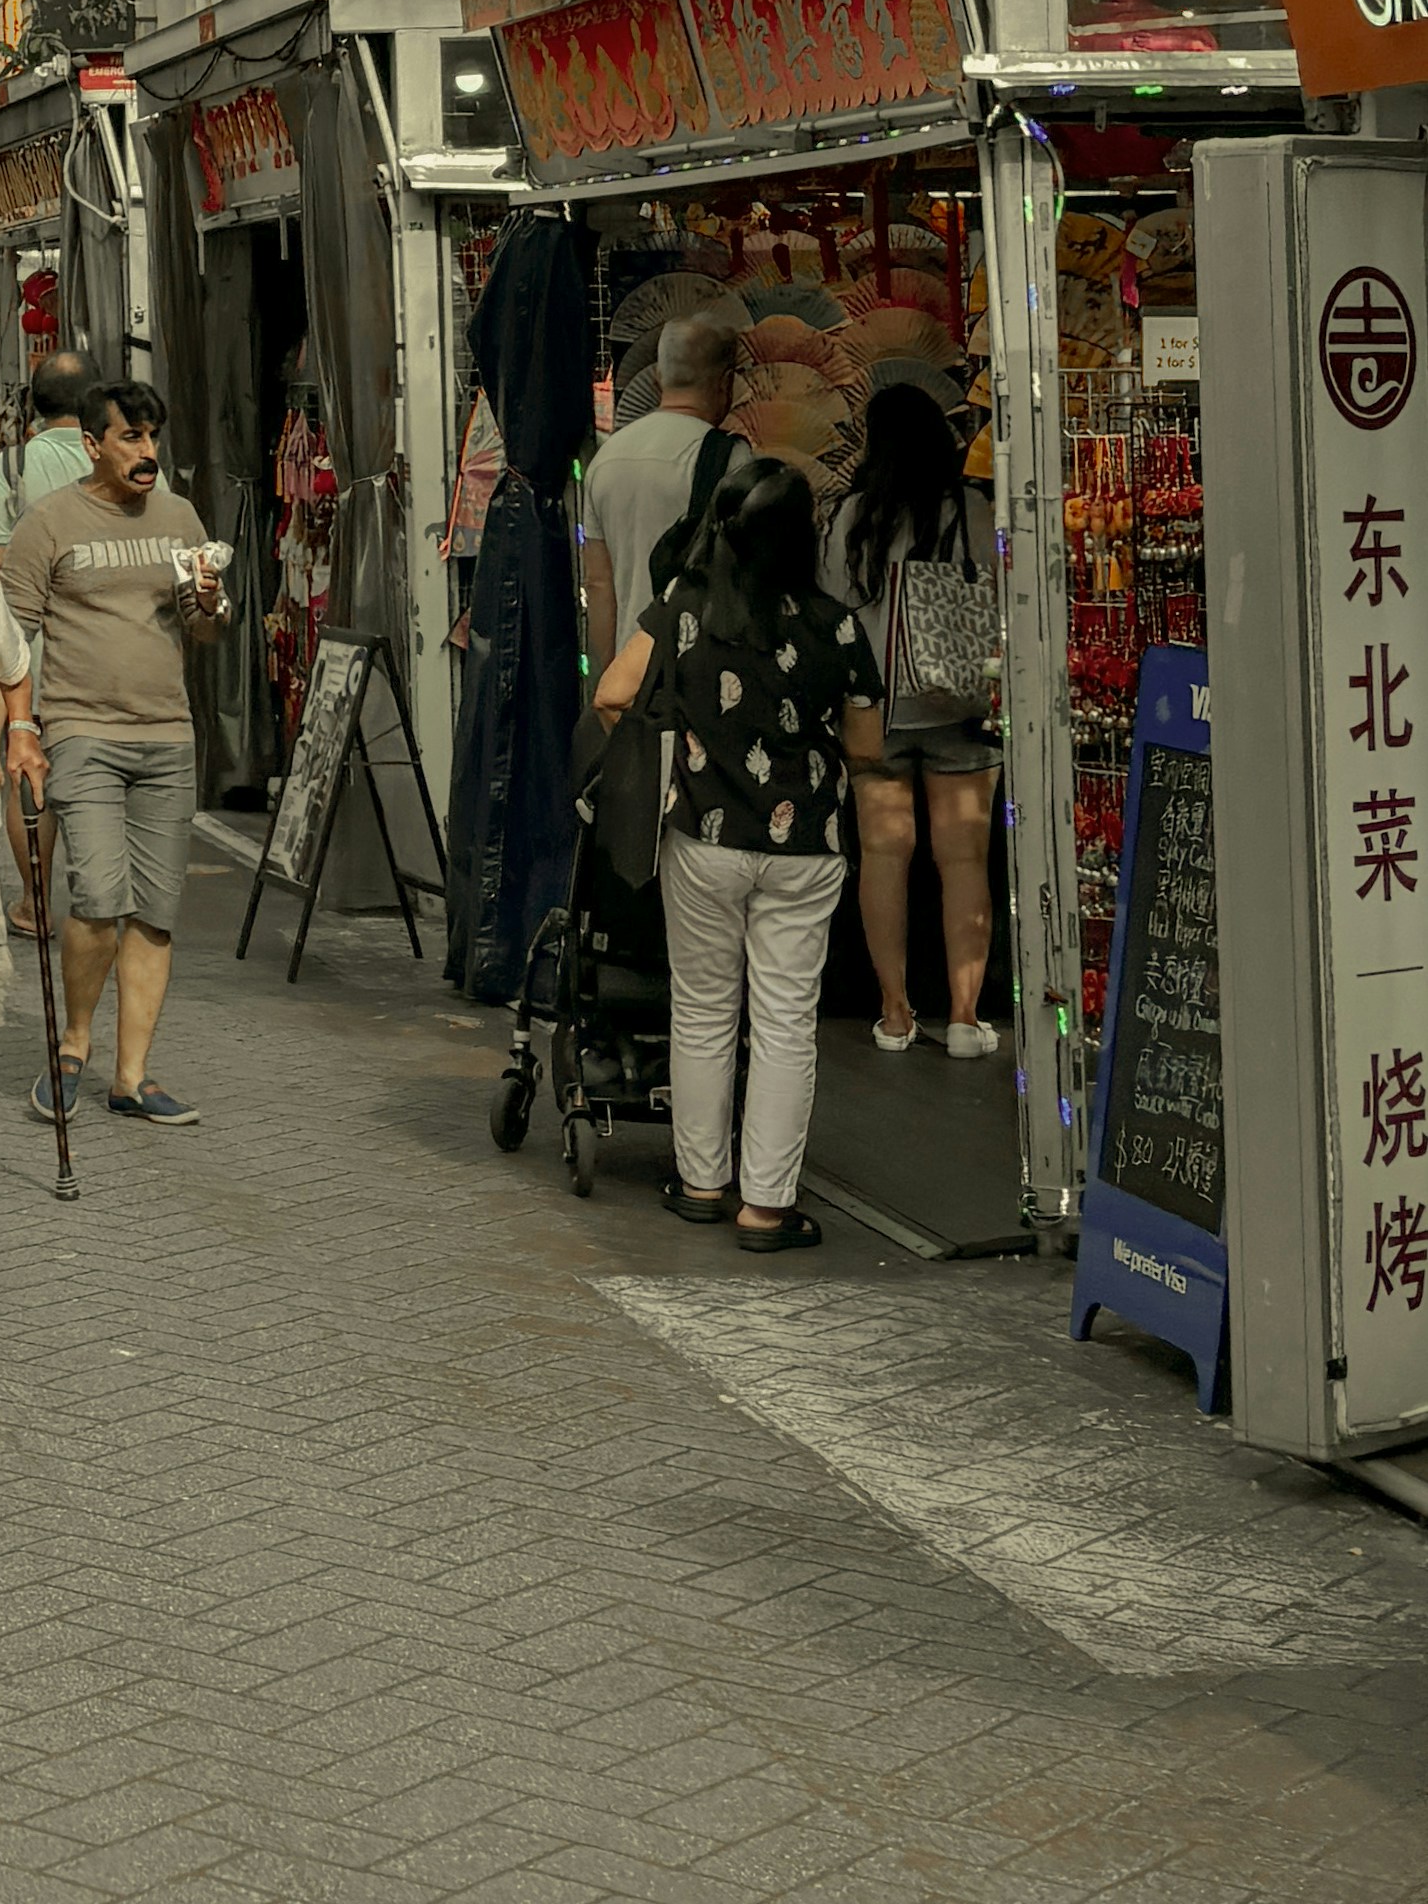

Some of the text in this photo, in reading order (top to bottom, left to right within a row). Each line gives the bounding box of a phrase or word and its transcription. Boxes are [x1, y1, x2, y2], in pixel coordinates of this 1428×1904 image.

[1189, 683, 1211, 721] VI
[1344, 494, 1428, 1312] 东北菜 烧烤
[1114, 1237, 1187, 1294] We prefer Visa
